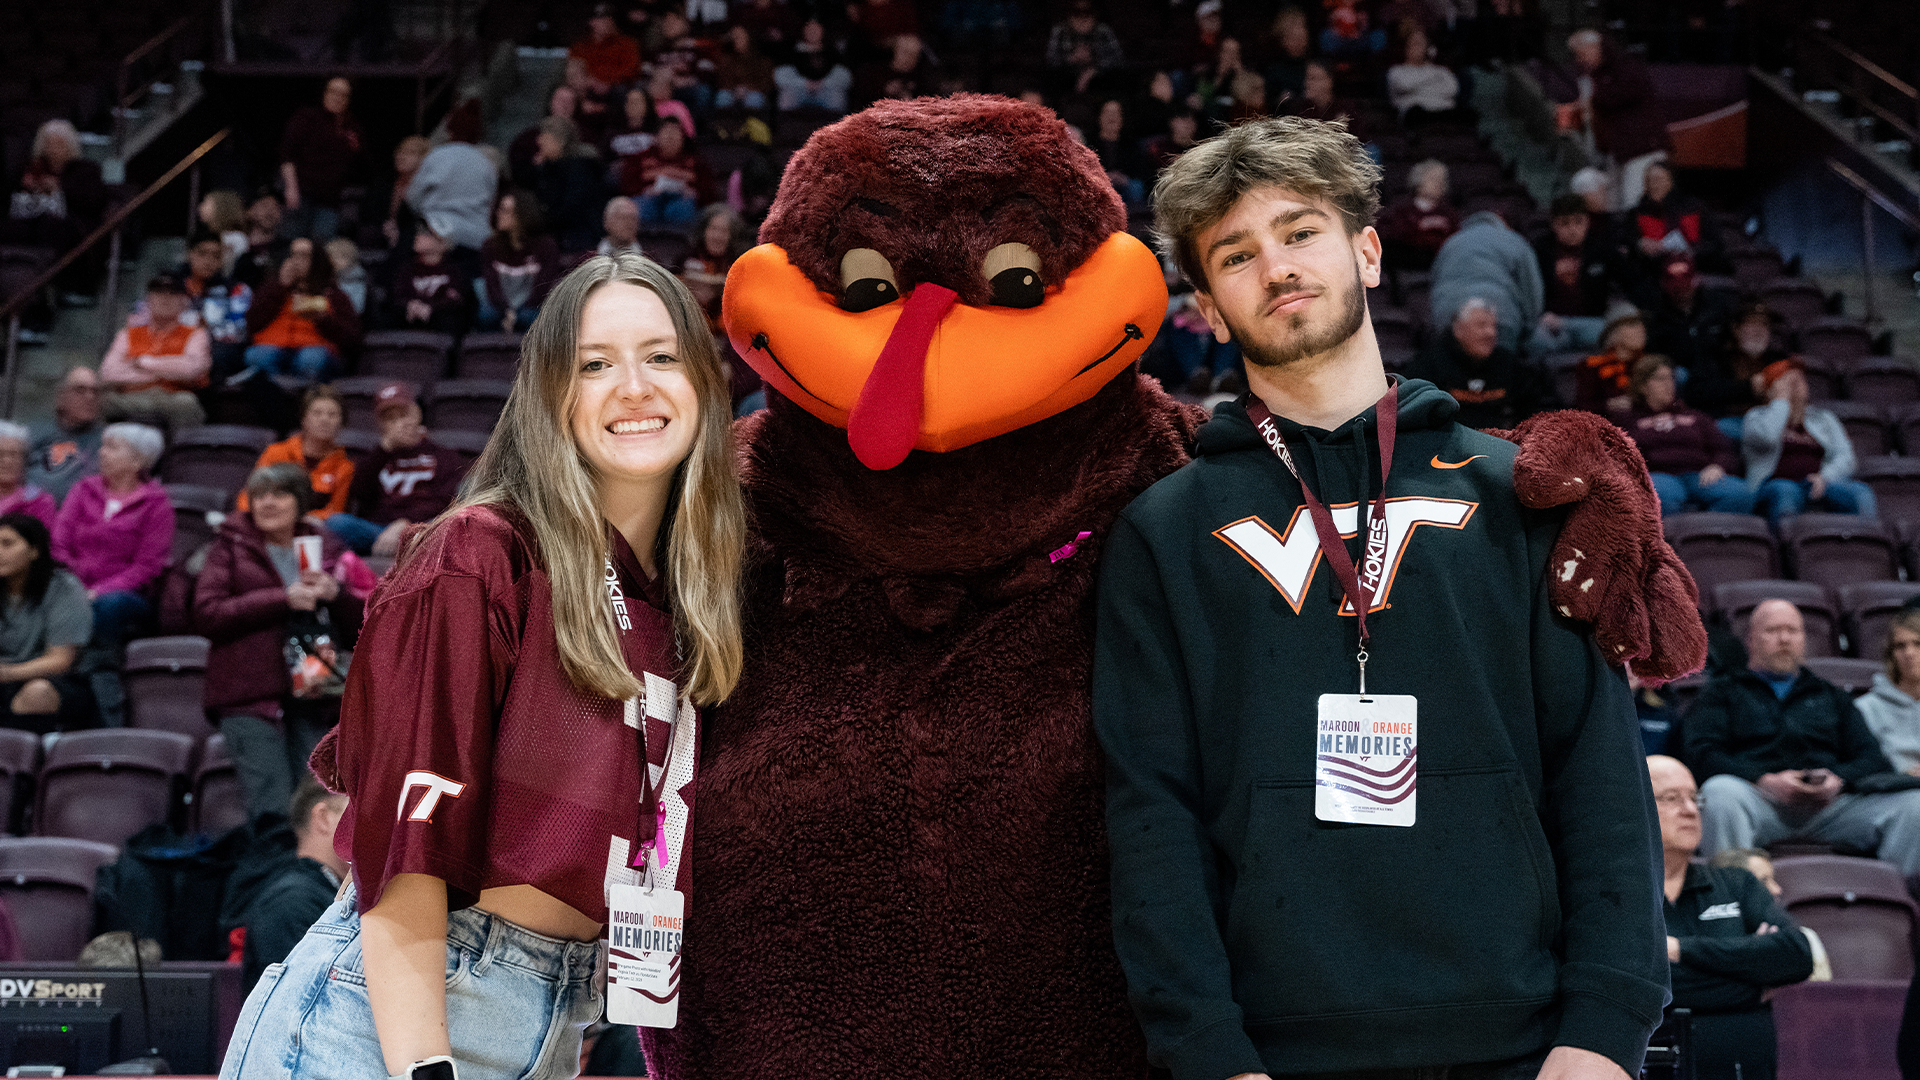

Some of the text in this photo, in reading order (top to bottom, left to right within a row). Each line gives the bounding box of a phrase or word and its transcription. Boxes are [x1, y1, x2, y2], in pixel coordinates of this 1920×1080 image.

[1211, 496, 1479, 616] VT
[1362, 518, 1386, 592] HOKIES
[1320, 720, 1360, 733] MAROON
[1372, 721, 1413, 735] ORANGE
[1319, 733, 1412, 757] MEMORIES
[613, 910, 644, 926] MAROON
[652, 914, 682, 930] ORANGE
[613, 925, 682, 953] MEMORIES
